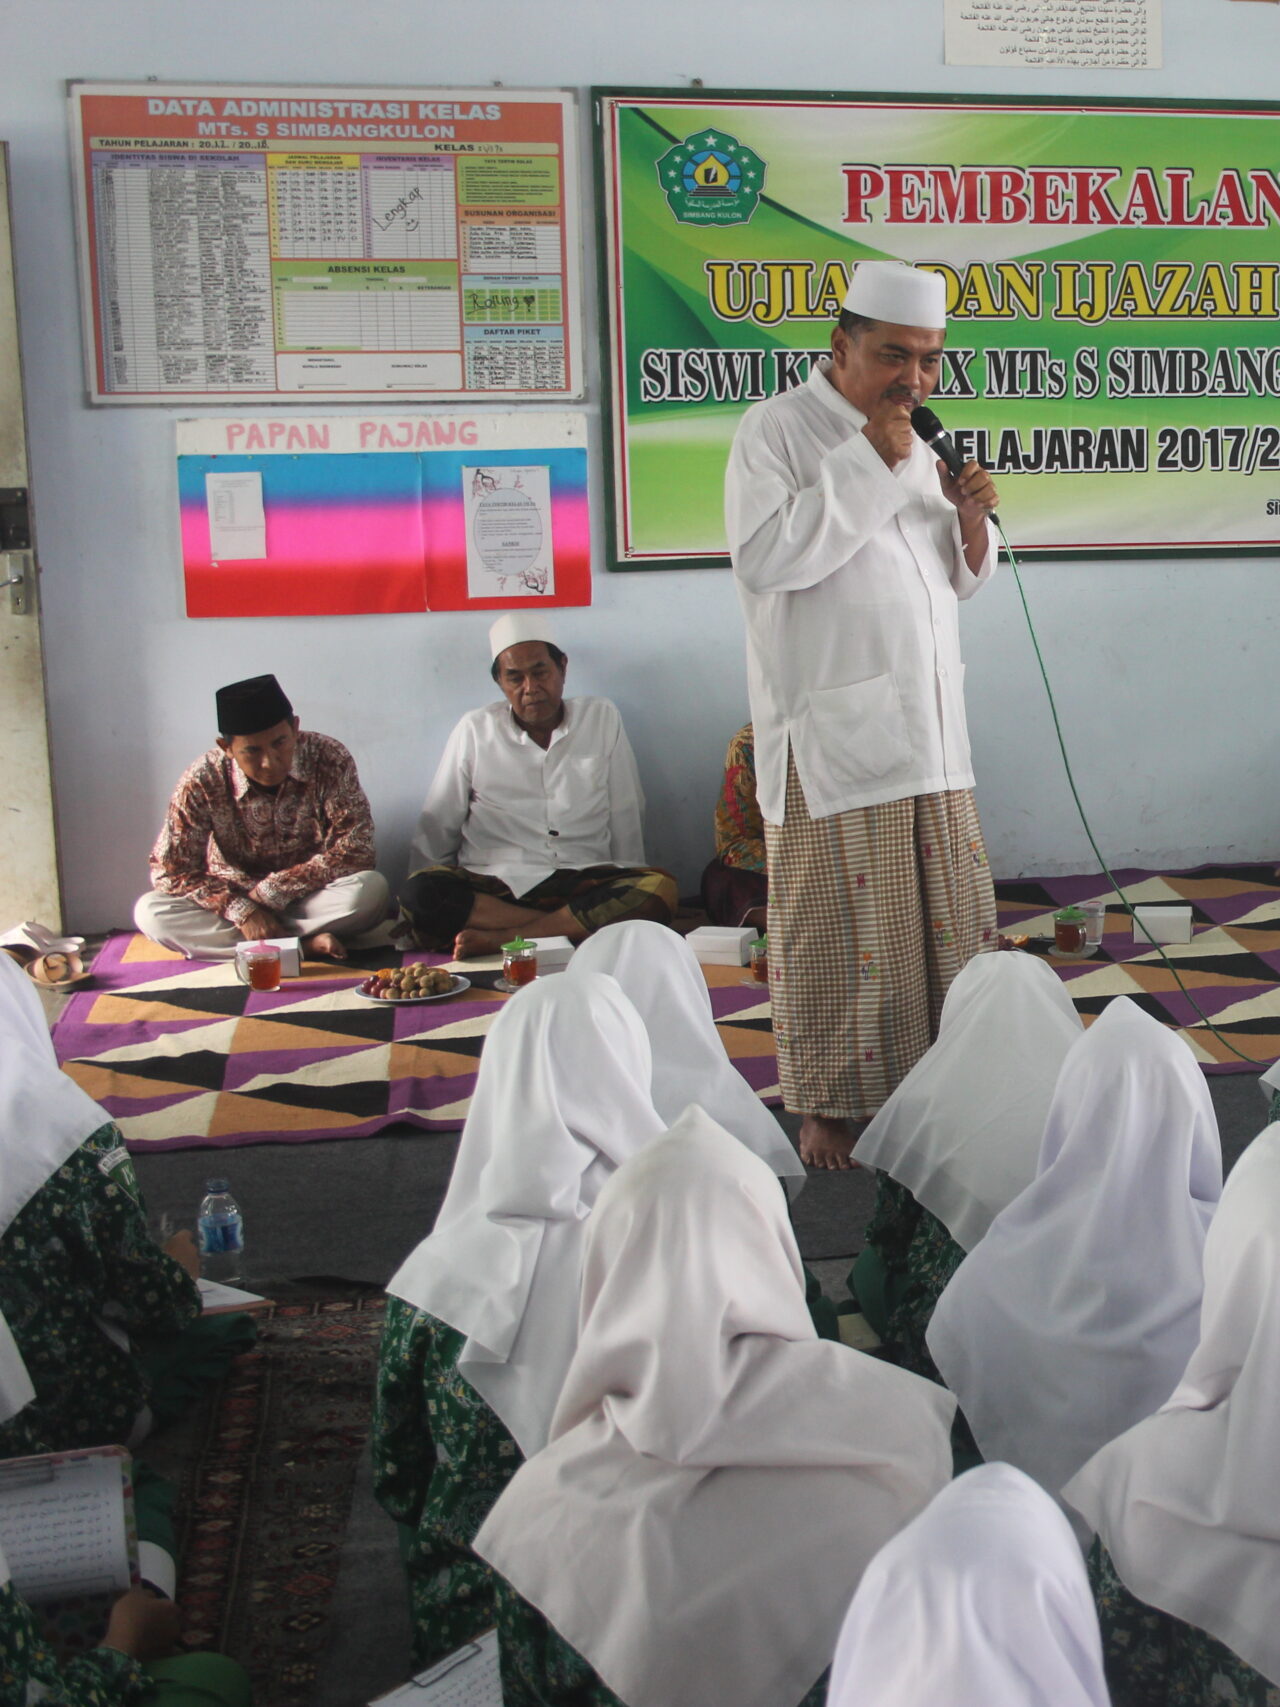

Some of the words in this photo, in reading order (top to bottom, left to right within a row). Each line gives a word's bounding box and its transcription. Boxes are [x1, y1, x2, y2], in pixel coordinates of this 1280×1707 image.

[148, 98, 216, 117] DATA
[223, 100, 411, 120] ADMINISTRASI
[418, 103, 502, 121] KELAS
[198, 122, 248, 136] MTs.
[255, 123, 270, 137] S
[276, 123, 456, 139] SIMBANGKULON
[98, 139, 132, 148] TAHUN
[133, 139, 189, 149] PELAJARAN
[434, 143, 475, 152] KELAS
[371, 186, 424, 231] Lengkap
[683, 211, 716, 219] SIMBANG
[717, 211, 743, 219] KULON
[327, 265, 371, 274] ABSENSI
[373, 265, 406, 274] KELAS
[703, 261, 849, 327] UJIA
[483, 328, 515, 336] DAFTAR
[517, 328, 541, 336] PIKET
[641, 349, 764, 400] SISWI
[984, 348, 1067, 398] MTs
[1075, 347, 1100, 399] S
[225, 422, 331, 450] PAPAN
[359, 421, 479, 448] PAJANG
[950, 428, 1149, 473] ELAJARAN
